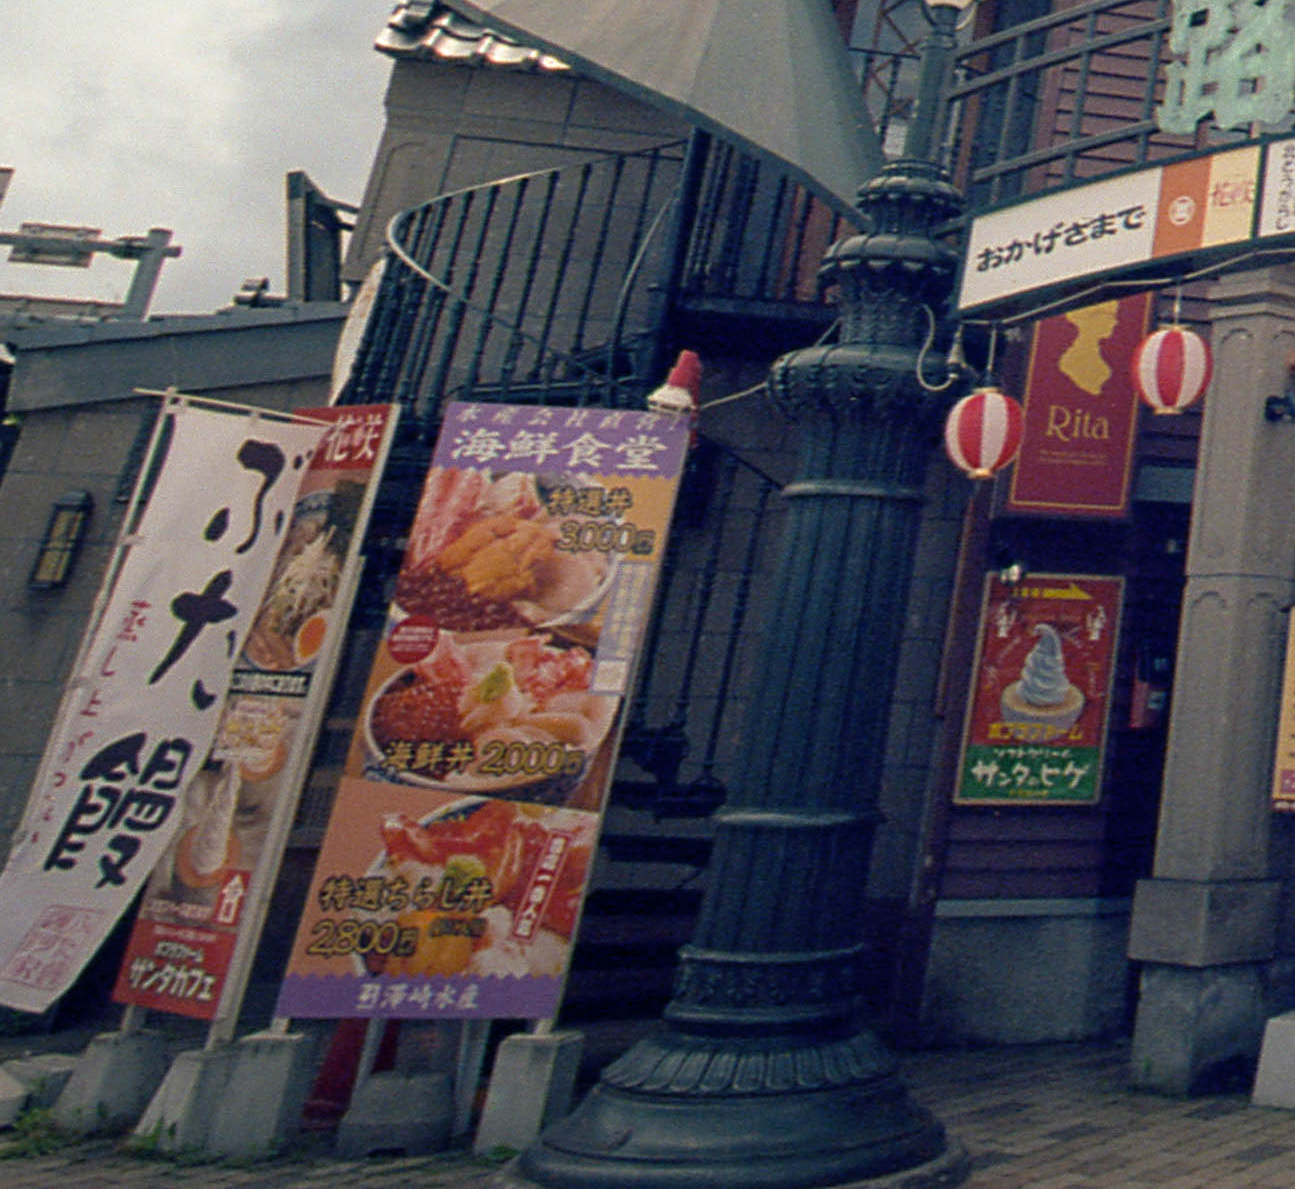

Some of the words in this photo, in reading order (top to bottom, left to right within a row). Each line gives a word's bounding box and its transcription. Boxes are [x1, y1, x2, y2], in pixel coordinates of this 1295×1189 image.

[975, 204, 1148, 273] おかげさまで
[1045, 404, 1109, 442] Rita
[452, 428, 668, 470] 海鮮食堂
